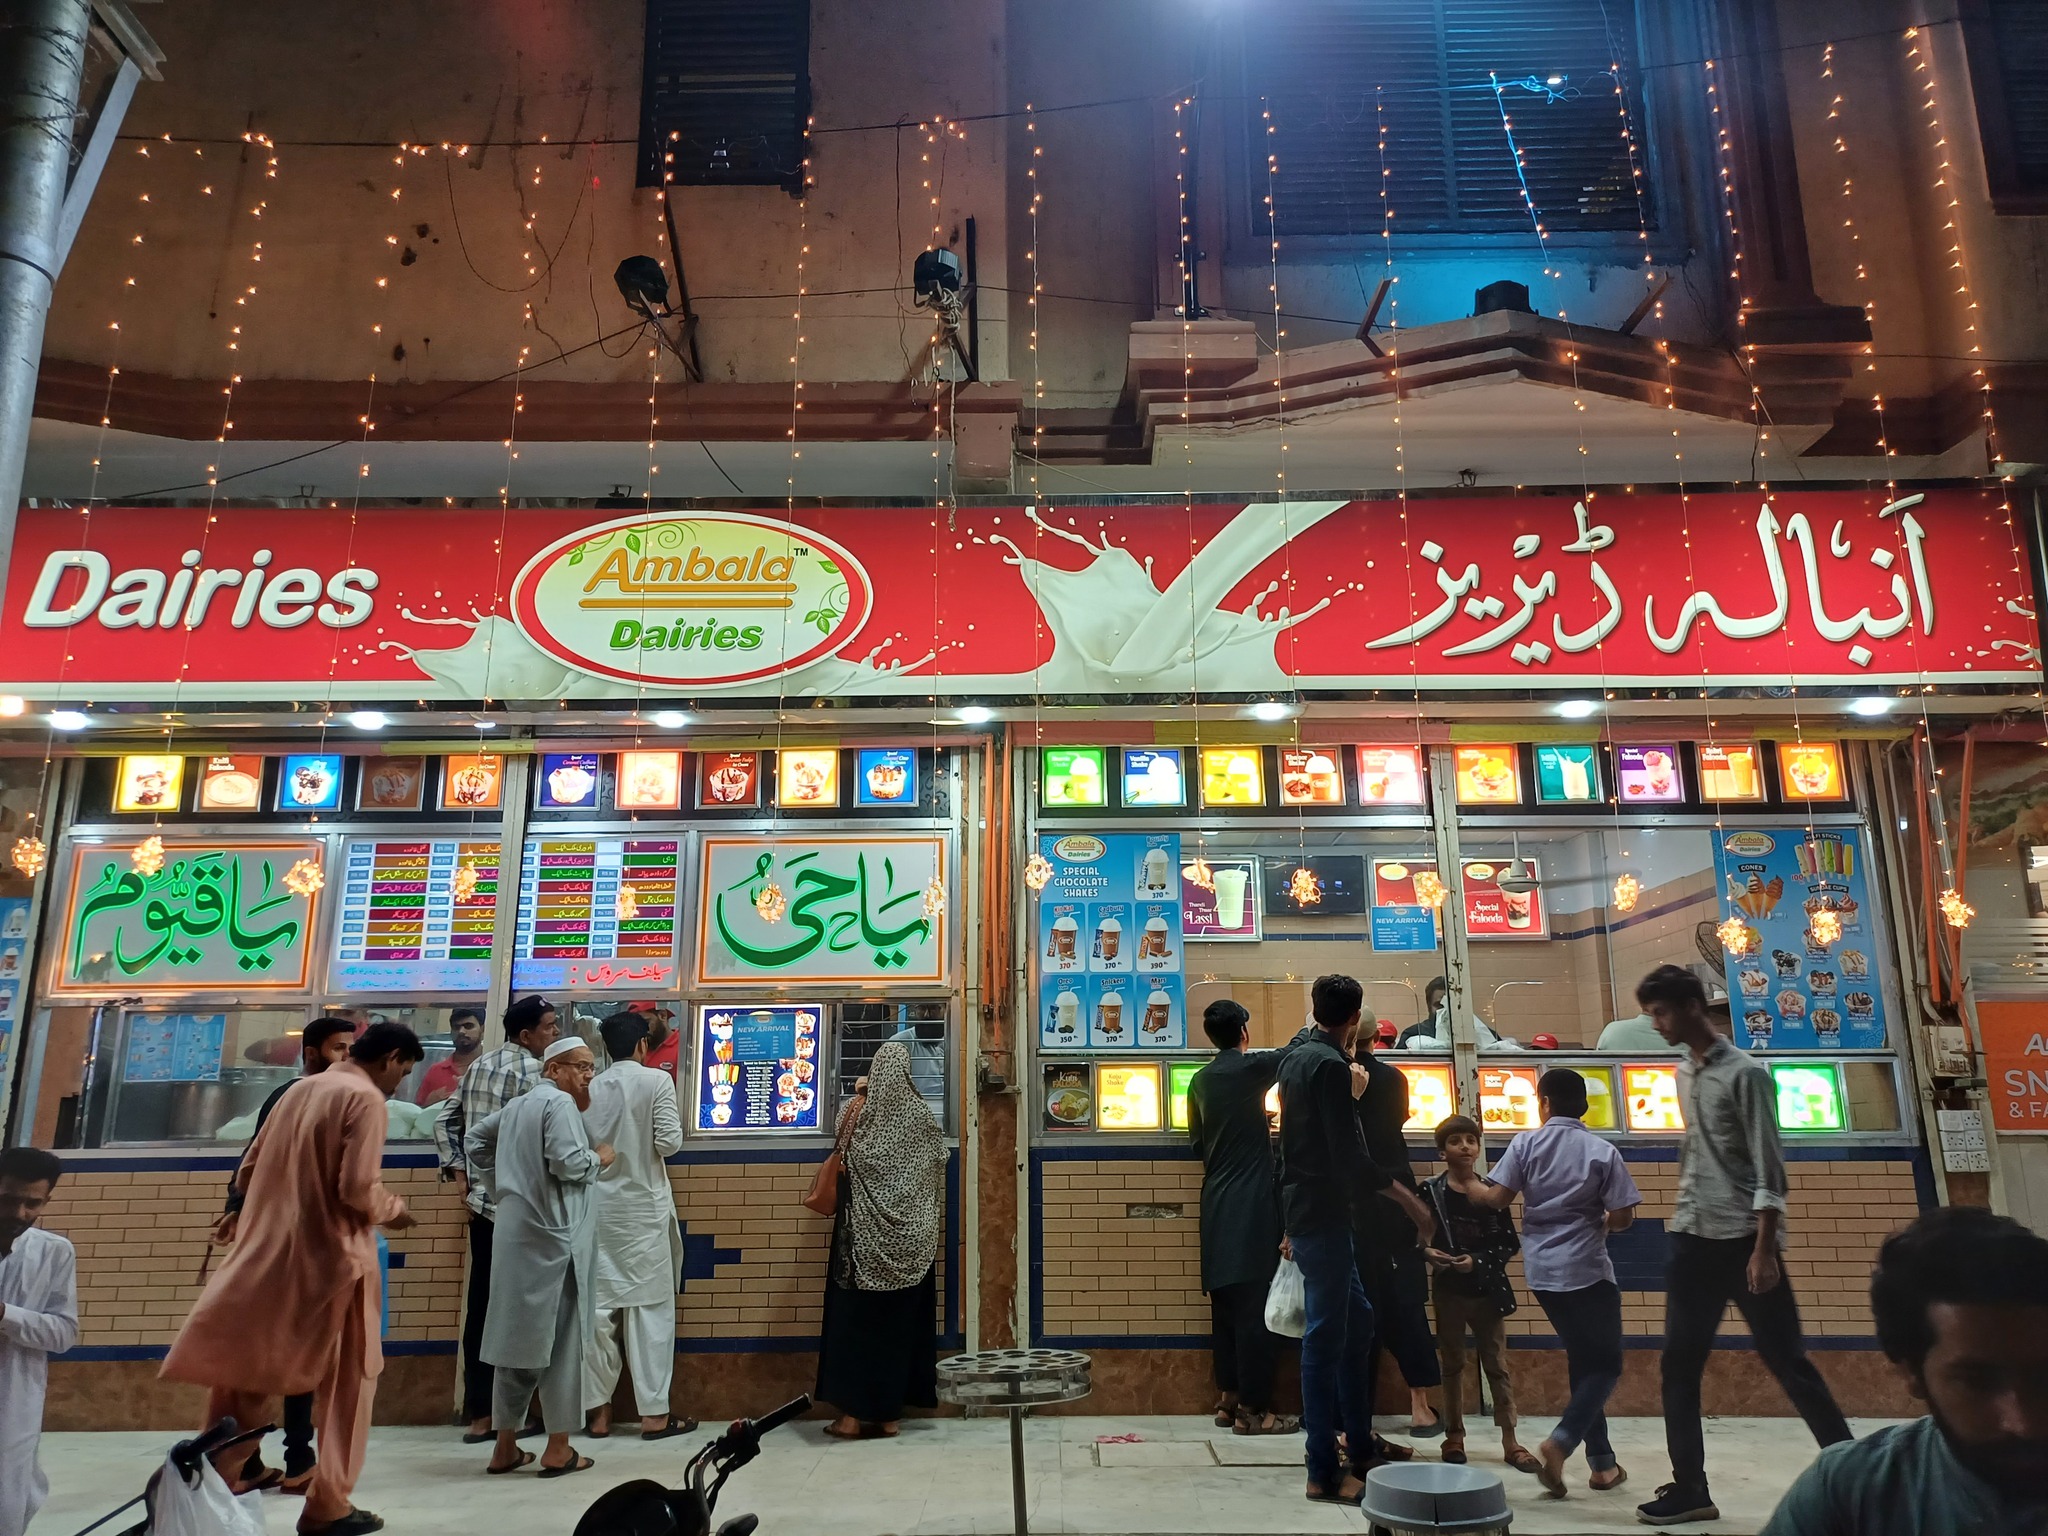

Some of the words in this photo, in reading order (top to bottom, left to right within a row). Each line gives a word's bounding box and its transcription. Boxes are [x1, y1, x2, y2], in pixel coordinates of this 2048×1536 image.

[583, 546, 797, 593] Ambala
[23, 549, 379, 629] Dairies
[609, 617, 764, 650] Dairies
[1063, 838, 1095, 848] Ambala
[1063, 867, 1100, 875] SPECIAL
[1054, 877, 1108, 886] CHOCOLATE
[1064, 888, 1099, 897] SHAKES
[1475, 901, 1499, 912] Special
[1184, 911, 1212, 925] Lassi
[1469, 911, 1504, 924] Falooda
[1058, 962, 1071, 970] 370
[1104, 962, 1117, 970] 370
[1150, 962, 1163, 970] 390
[628, 962, 673, 982] سیلف
[1101, 977, 1126, 986] Snickers
[1150, 977, 1166, 985] Mars
[756, 1025, 789, 1033] ARRIVAL
[1059, 1035, 1072, 1044] 350
[1105, 1035, 1118, 1044] 370
[1154, 1035, 1167, 1044] 370
